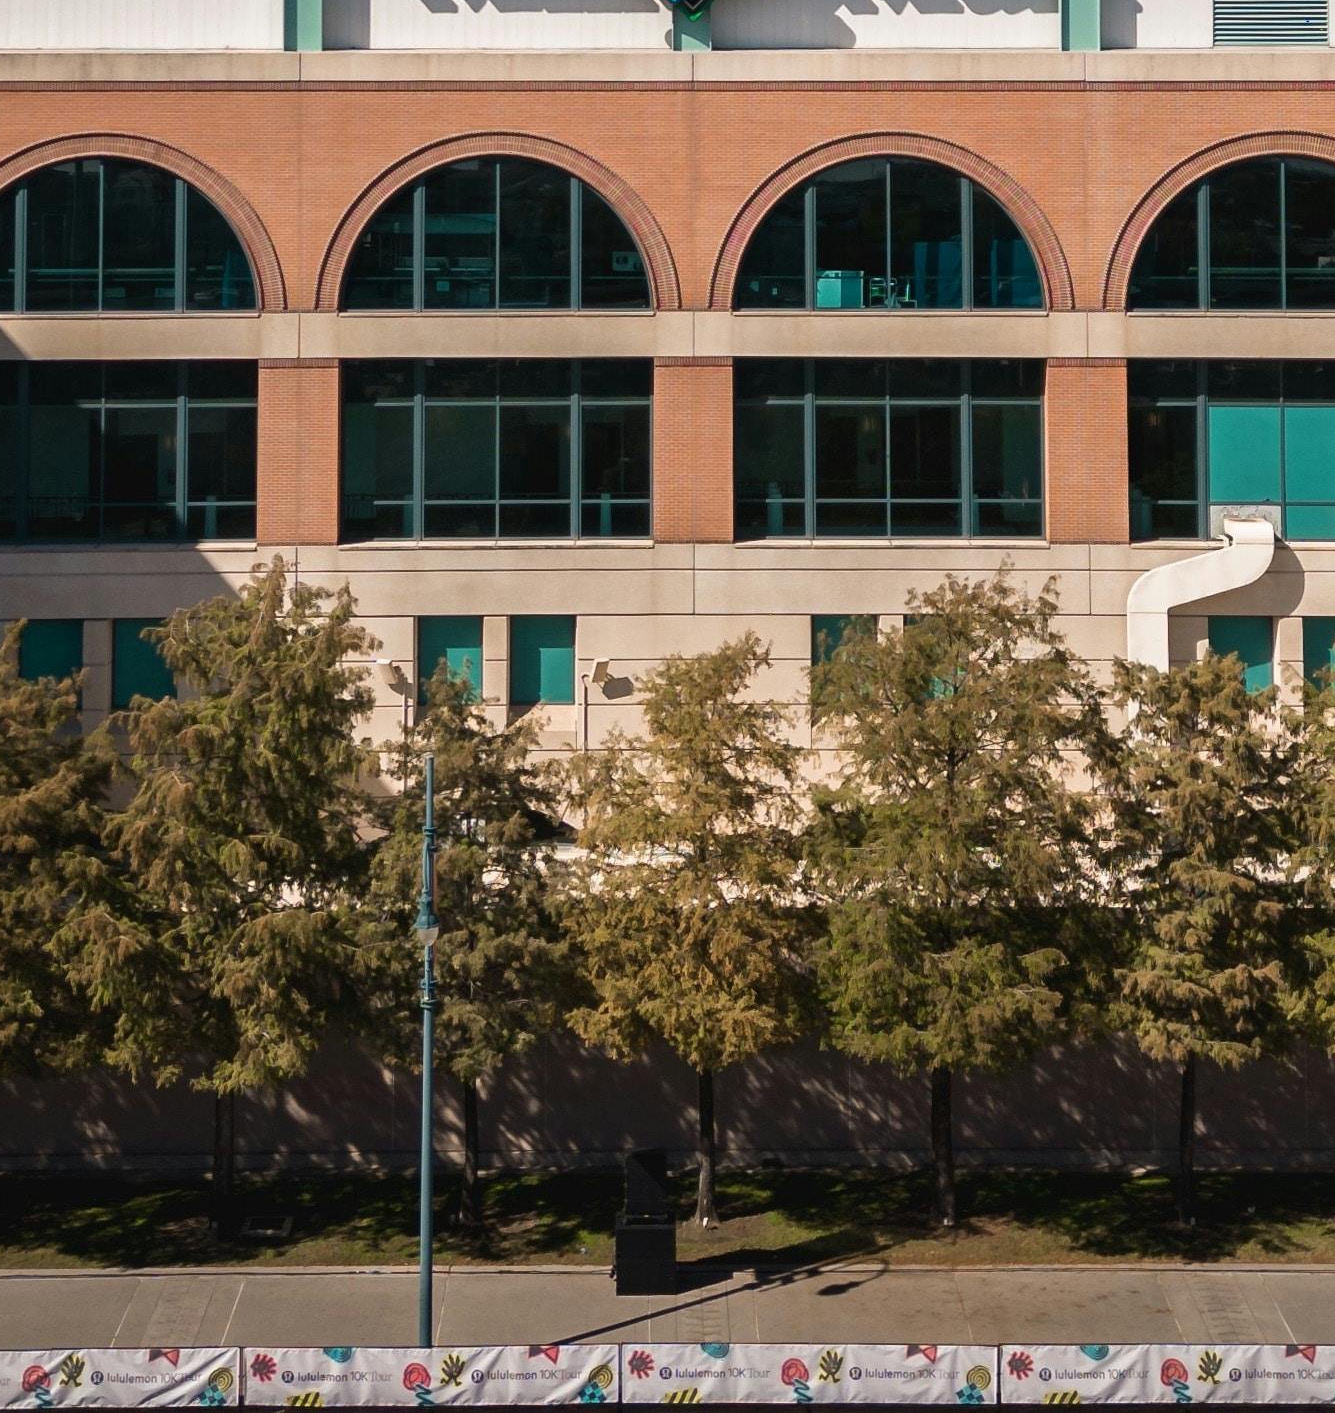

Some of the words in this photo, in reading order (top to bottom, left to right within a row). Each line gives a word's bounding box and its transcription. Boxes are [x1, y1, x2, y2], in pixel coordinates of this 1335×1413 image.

[107, 1373, 157, 1384] lululemon
[160, 1373, 178, 1383] 10K
[297, 1372, 348, 1382] lululemon
[351, 1371, 369, 1382] 10K
[371, 1372, 392, 1382] Tour
[487, 1369, 536, 1380] lululemon
[539, 1369, 558, 1380] 10K
[560, 1369, 581, 1380] Tour
[675, 1368, 725, 1379] lululemon
[728, 1368, 746, 1378] 10K
[749, 1369, 770, 1378] Tour
[865, 1368, 915, 1379] lululemon
[919, 1368, 936, 1379] 10K
[939, 1369, 960, 1379] Tour
[1055, 1369, 1105, 1380] lululemon
[1108, 1369, 1126, 1379] 10K
[1128, 1369, 1149, 1379] Tour
[1245, 1369, 1295, 1380] lululemon
[1298, 1369, 1316, 1380] 10K
